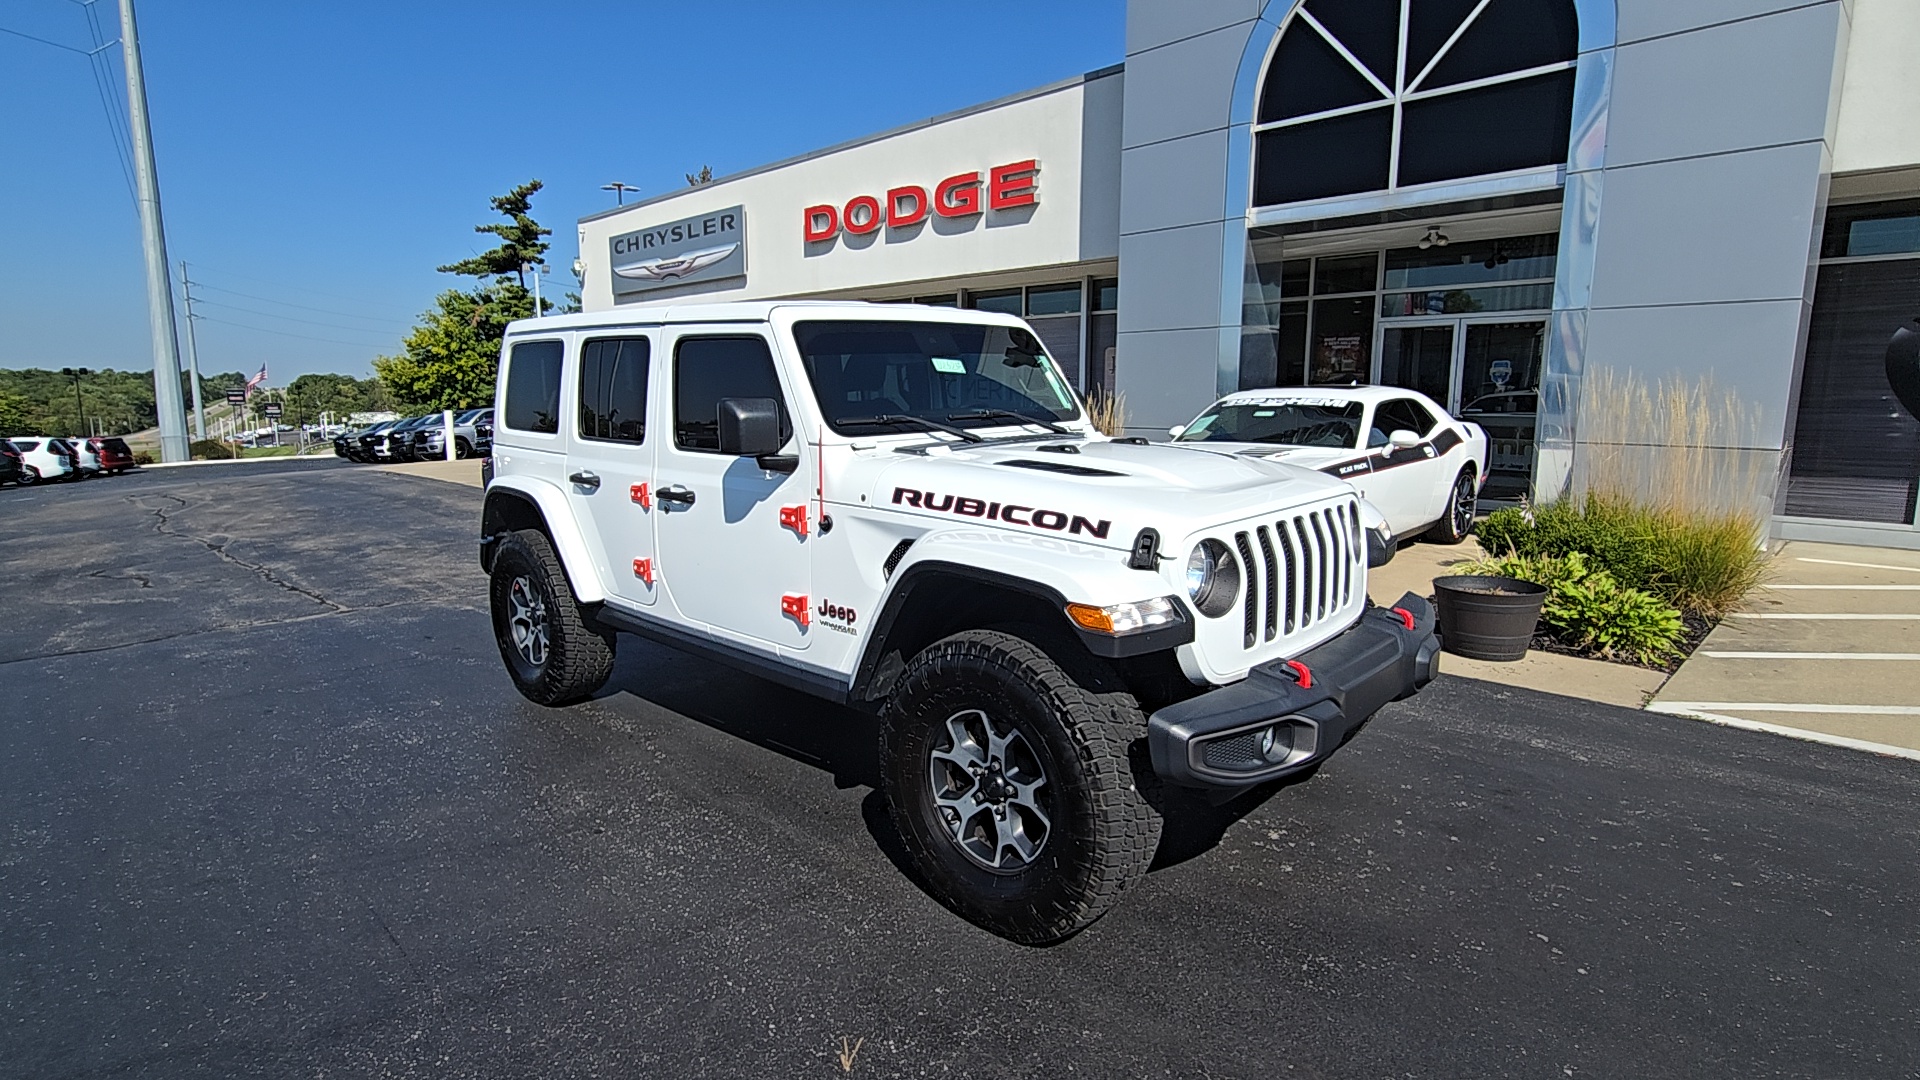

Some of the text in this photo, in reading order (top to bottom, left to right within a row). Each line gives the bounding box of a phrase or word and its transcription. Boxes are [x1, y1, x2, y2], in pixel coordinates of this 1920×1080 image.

[804, 160, 1040, 243] DODGE
[613, 213, 736, 255] CHRYSLER
[1285, 397, 1349, 408] HEMI
[891, 486, 1112, 540] RUBICON
[817, 598, 857, 626] Jeep
